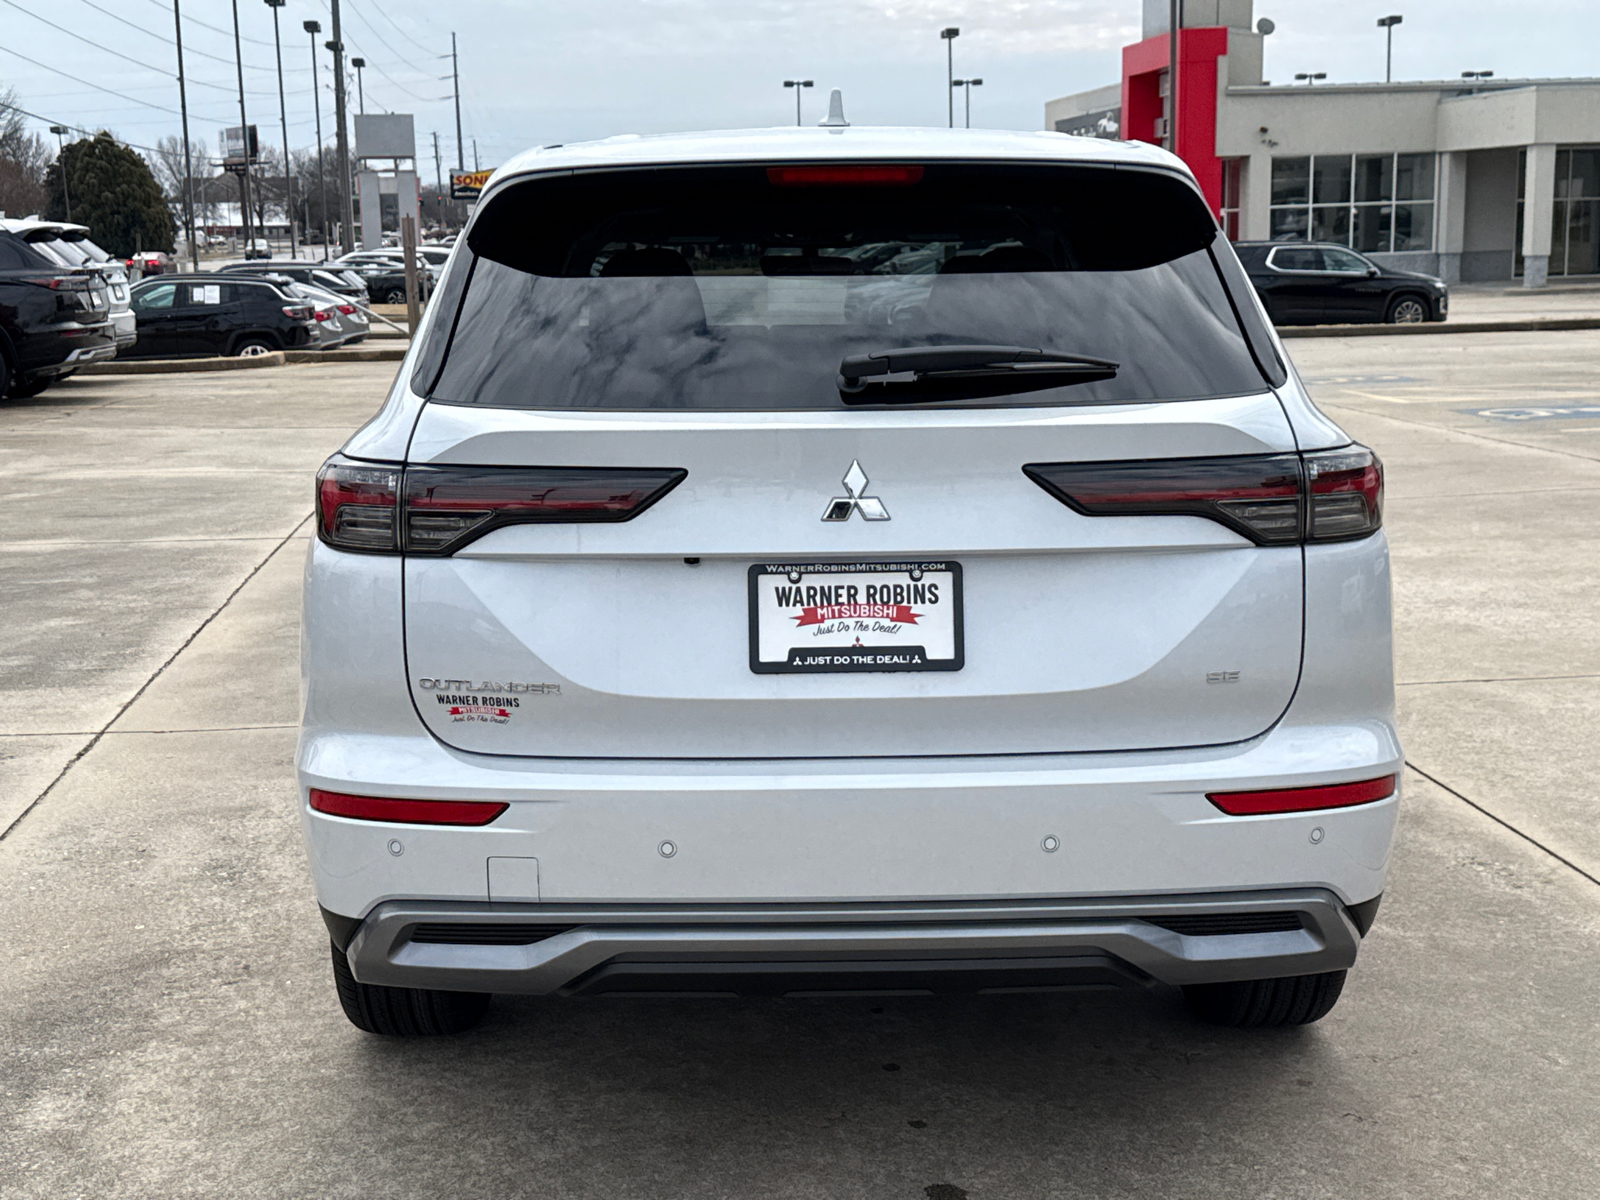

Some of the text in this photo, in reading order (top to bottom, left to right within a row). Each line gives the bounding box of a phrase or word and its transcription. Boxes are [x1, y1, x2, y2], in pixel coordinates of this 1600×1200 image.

[775, 583, 939, 607] WARNER ROBINS
[817, 605, 897, 619] MITSUBISHI
[813, 620, 902, 637] Just Do The Deal!
[804, 655, 909, 665] JUST DO THE DEAL!
[1206, 670, 1241, 683] SE
[419, 677, 562, 695] OUTLANDER
[436, 694, 520, 708] WARNER ROBINS
[451, 715, 465, 723] Just
